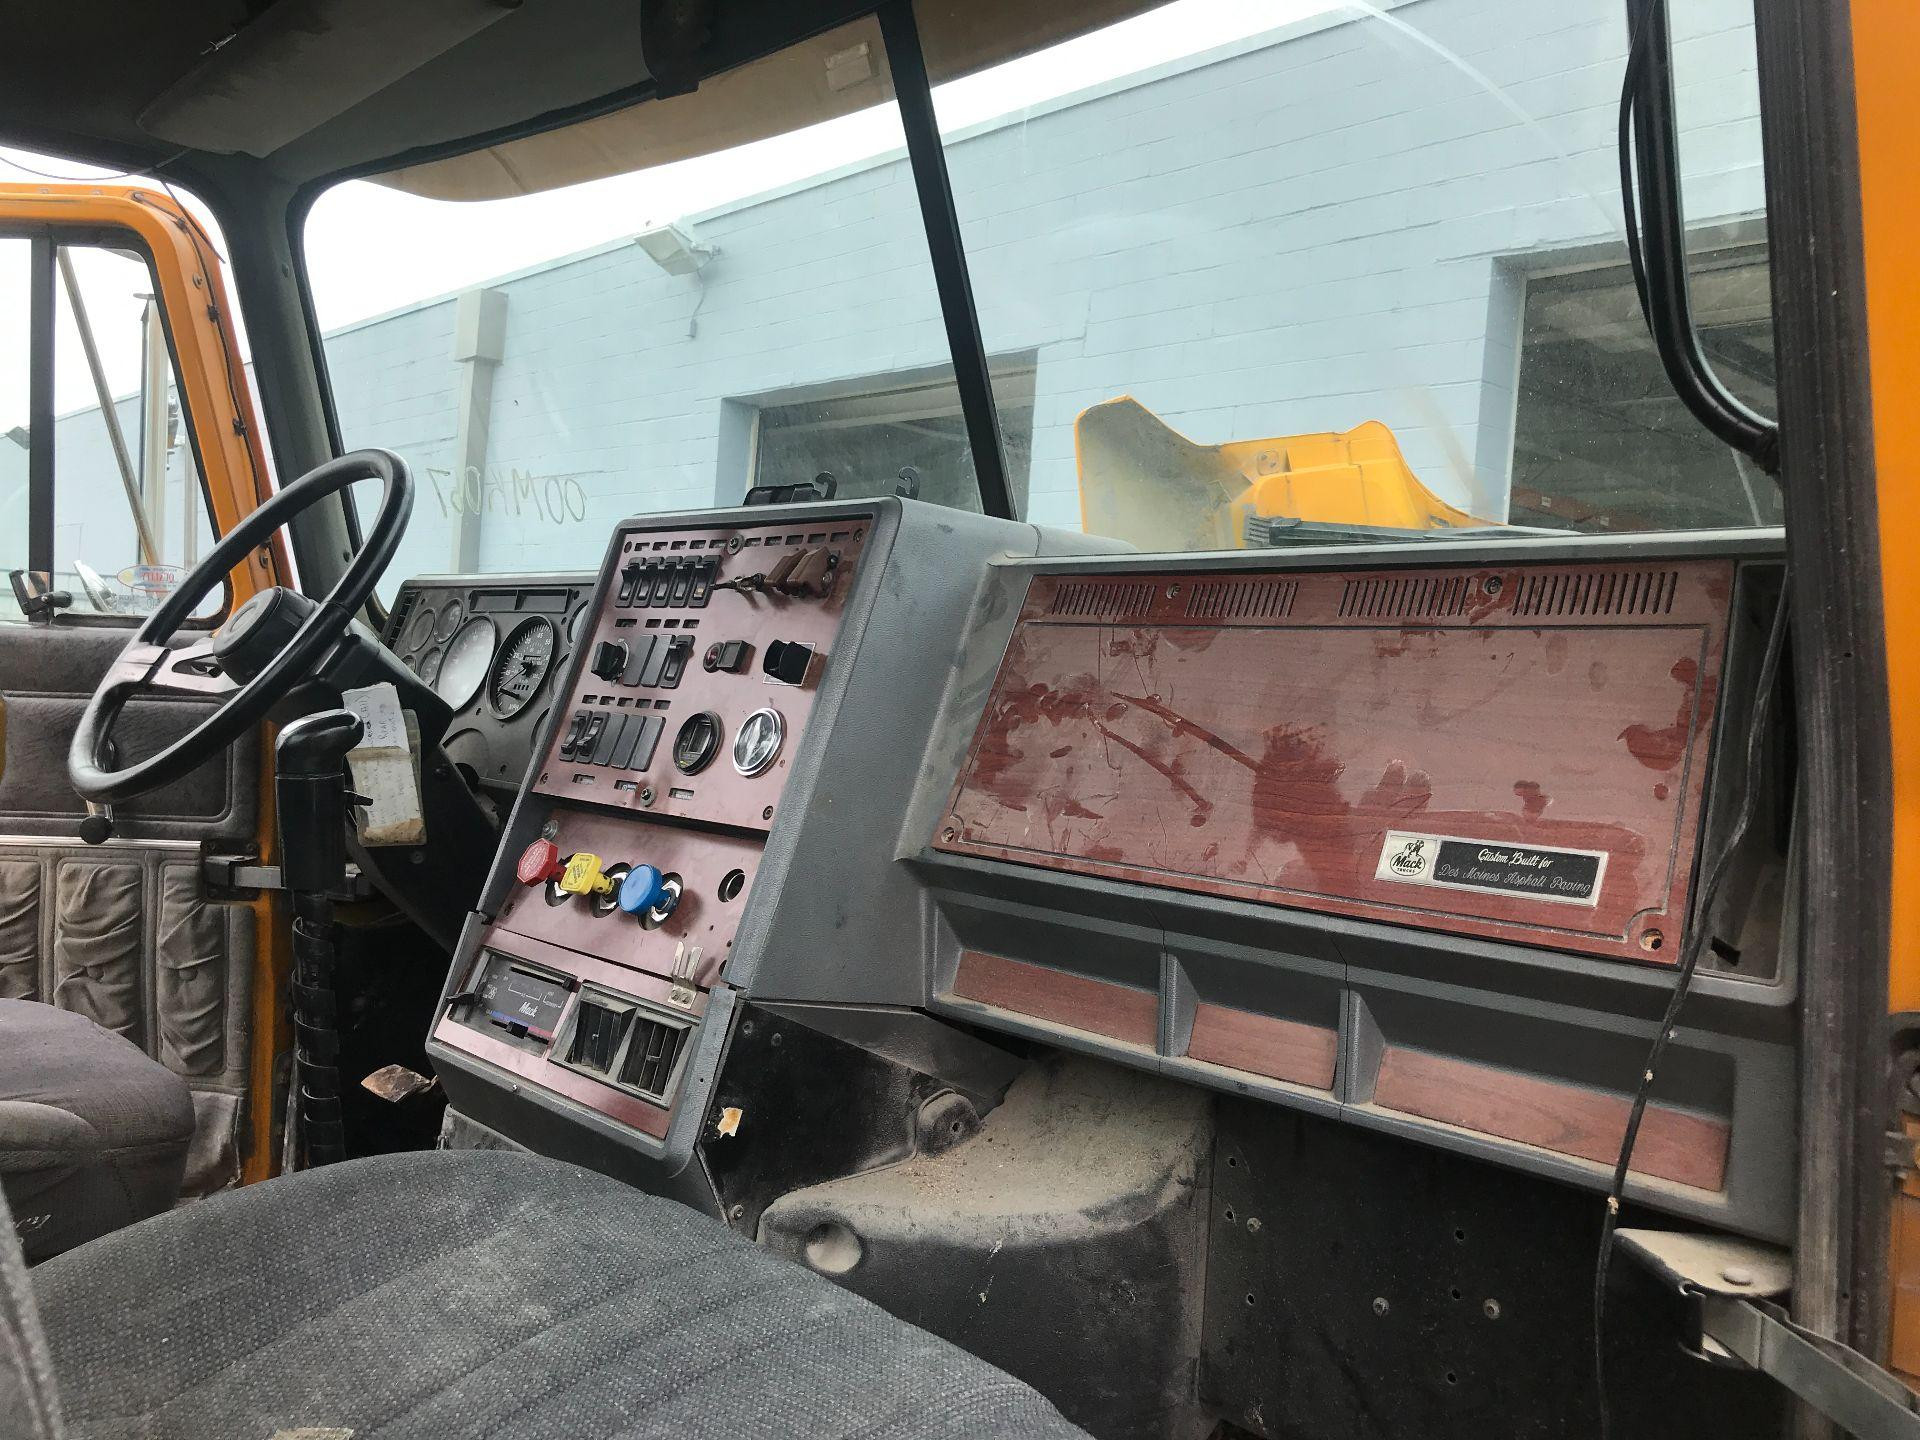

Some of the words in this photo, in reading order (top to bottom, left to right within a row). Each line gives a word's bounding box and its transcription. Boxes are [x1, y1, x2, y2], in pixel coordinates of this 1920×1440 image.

[1392, 855, 1422, 869] Mack
[1477, 848, 1509, 864] Custom
[1508, 851, 1538, 867] Built
[1538, 857, 1554, 869] for
[1438, 863, 1459, 878] Des
[1462, 866, 1501, 882] Moines
[1504, 870, 1547, 888] Asphalt
[1549, 876, 1591, 896] Paving
